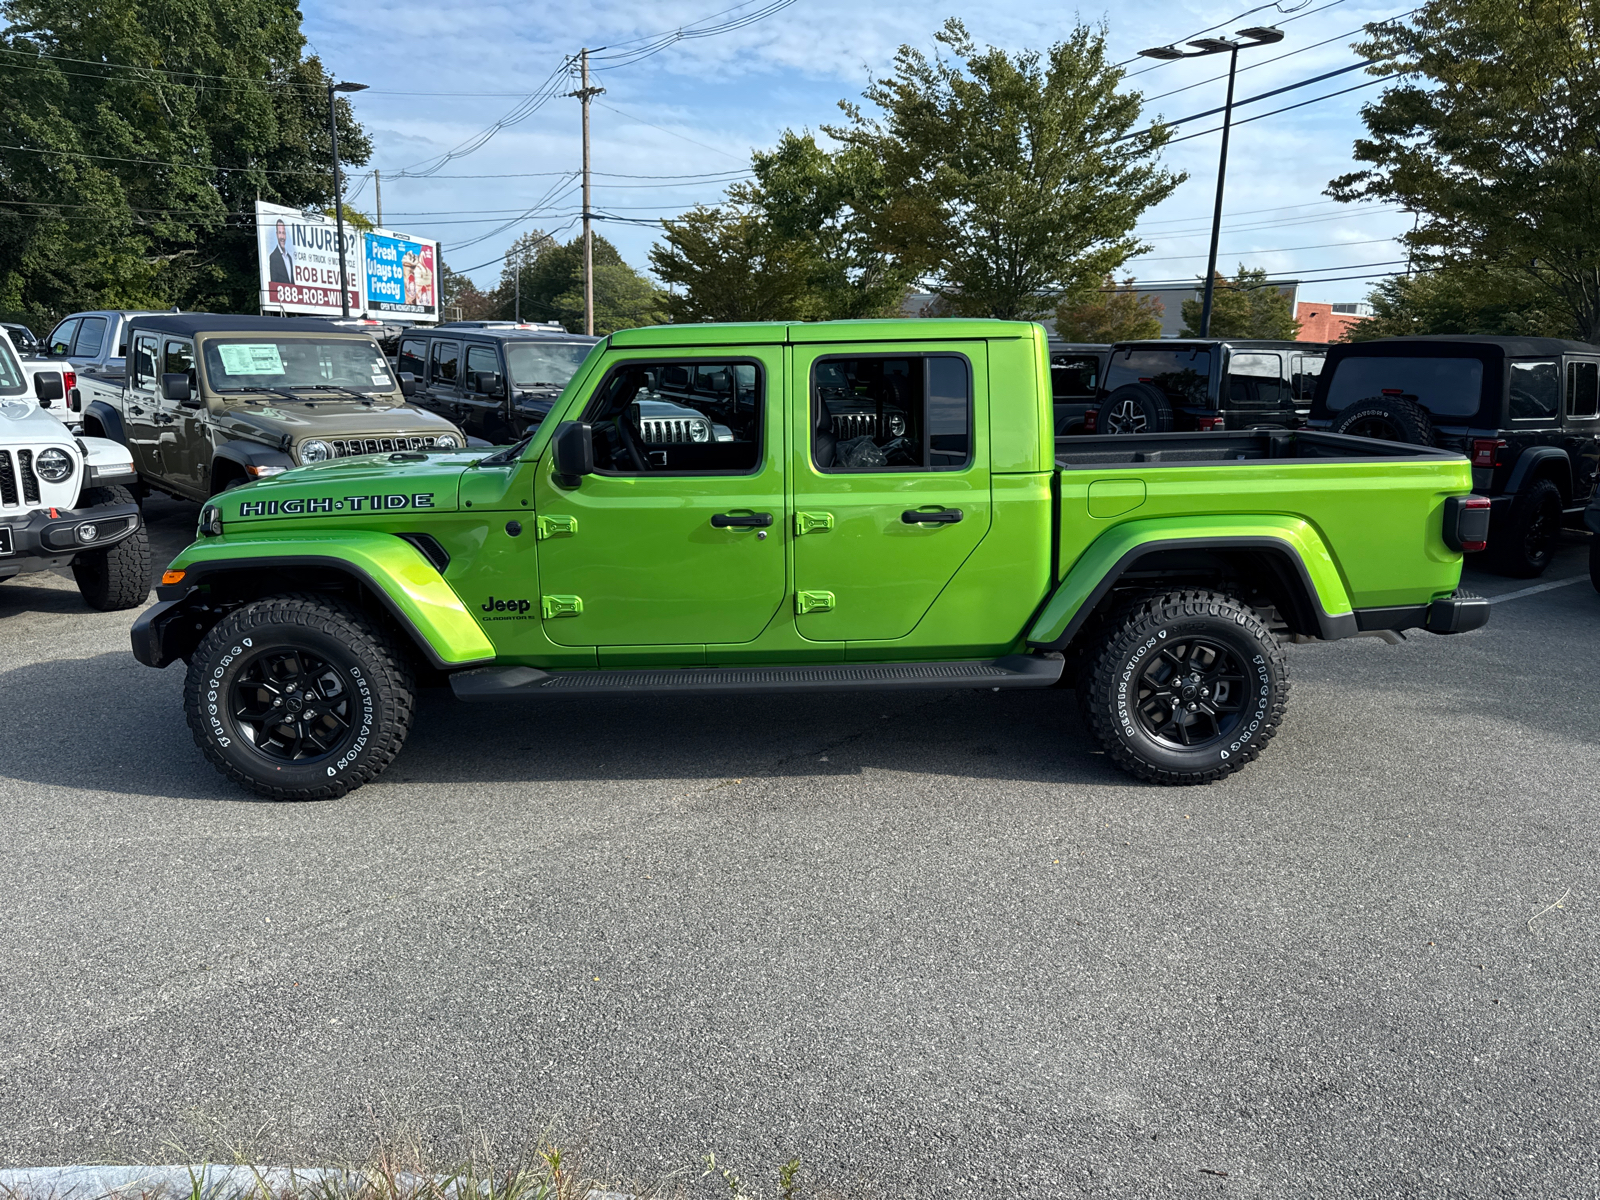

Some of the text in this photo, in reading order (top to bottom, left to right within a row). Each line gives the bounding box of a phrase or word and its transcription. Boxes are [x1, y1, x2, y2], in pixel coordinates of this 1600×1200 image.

[292, 222, 355, 256] INJURED?
[372, 241, 397, 261] Fresh
[295, 265, 357, 287] ROB LEVNE
[367, 258, 402, 281] Ways to
[277, 285, 354, 307] 888-ROB-WIS
[371, 276, 401, 300] Frosty
[240, 492, 434, 516] HIGH TIDE
[482, 596, 530, 614] Jeep
[207, 646, 242, 748] Firestone
[1118, 637, 1156, 737] DESTINATION
[1230, 655, 1269, 752] Firestone
[337, 666, 373, 770] DESTINATION
